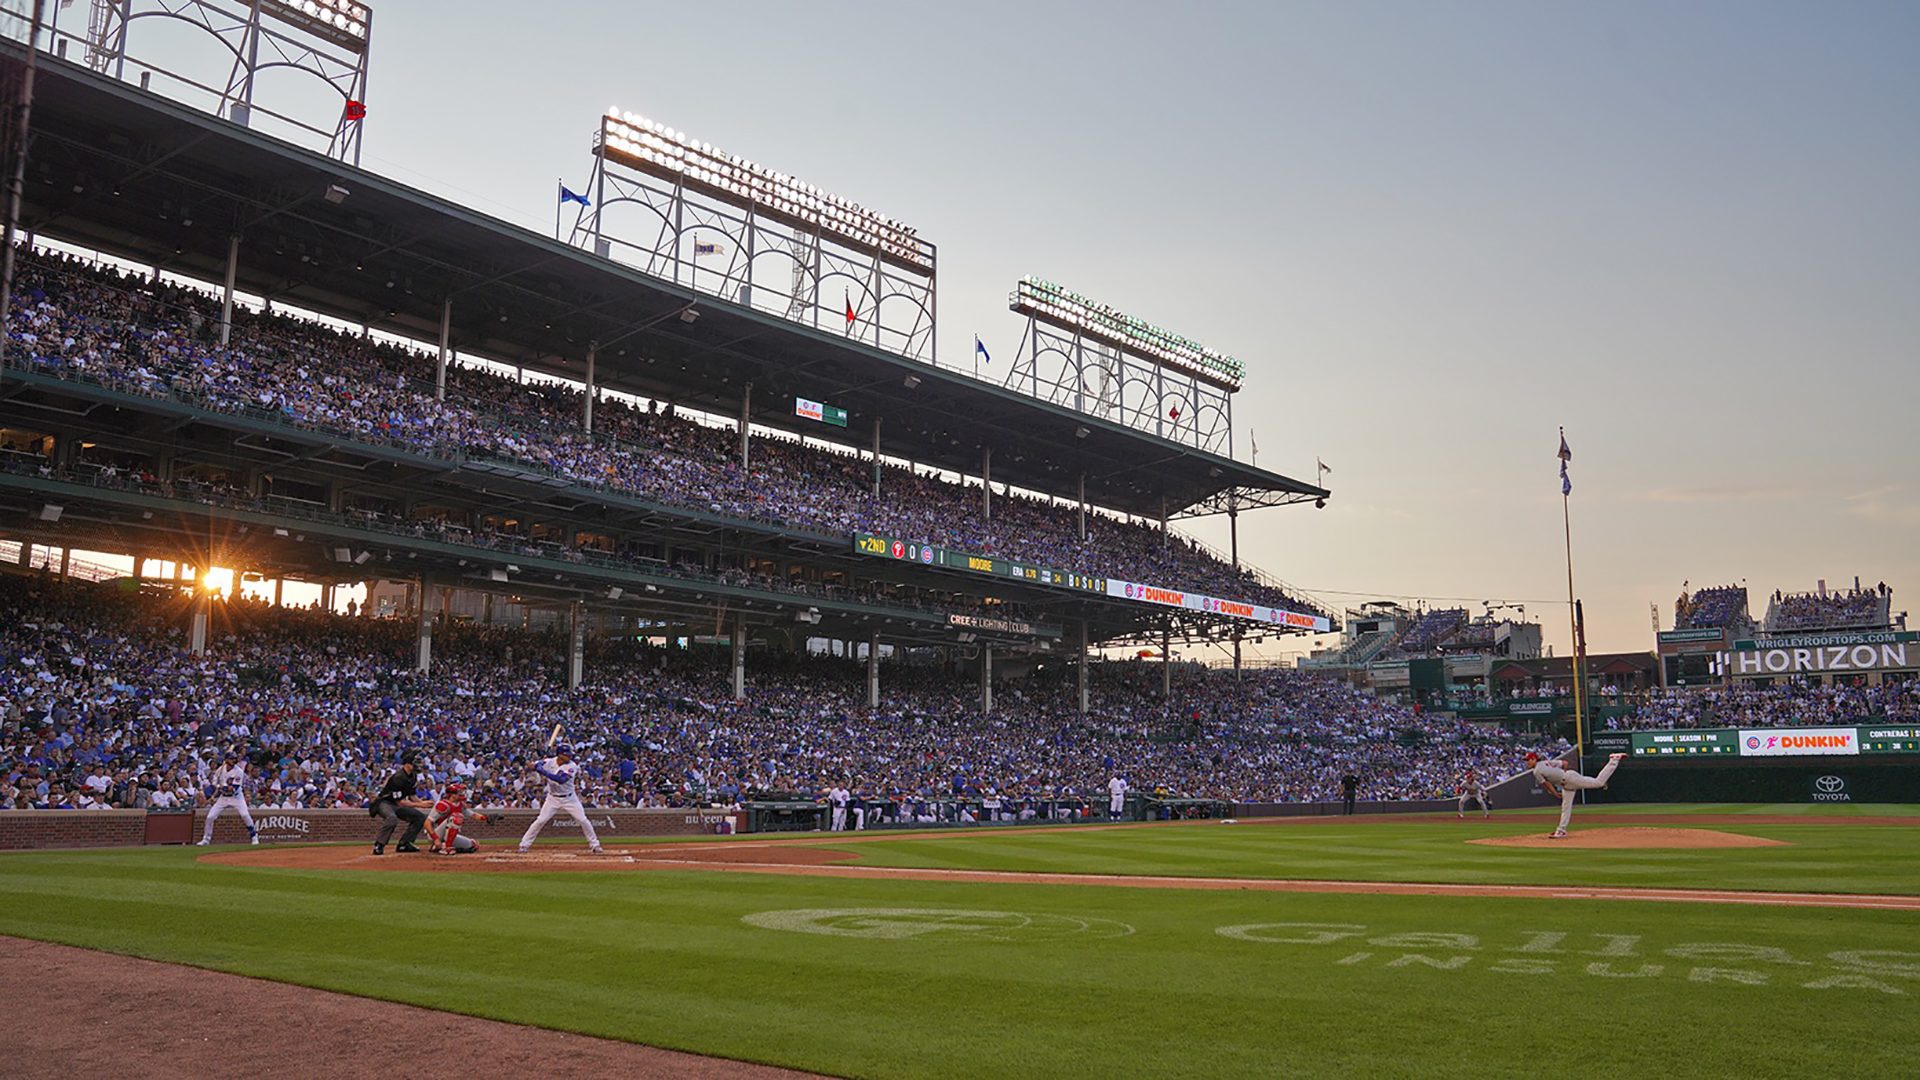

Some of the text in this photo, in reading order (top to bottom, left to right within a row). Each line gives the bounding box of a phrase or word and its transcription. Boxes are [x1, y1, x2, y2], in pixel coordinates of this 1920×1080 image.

[867, 537, 886, 554] 2ND
[909, 545, 916, 560] 0
[969, 557, 993, 572] MOORE
[1012, 566, 1024, 577] ERA
[1068, 573, 1074, 587] B
[1081, 576, 1088, 589] S
[1145, 587, 1184, 606] DUNKIN'
[1220, 601, 1255, 617] DUNKIN'
[950, 614, 1030, 634] CREE LIGHTING CLUB
[1286, 613, 1316, 628] DUNKIN'
[1739, 643, 1907, 673] HORIZON
[1509, 702, 1552, 711] GRAINGER
[1781, 735, 1850, 748] DUNKIN'
[1869, 730, 1909, 738] CONTRERAS
[552, 819, 580, 827] America
